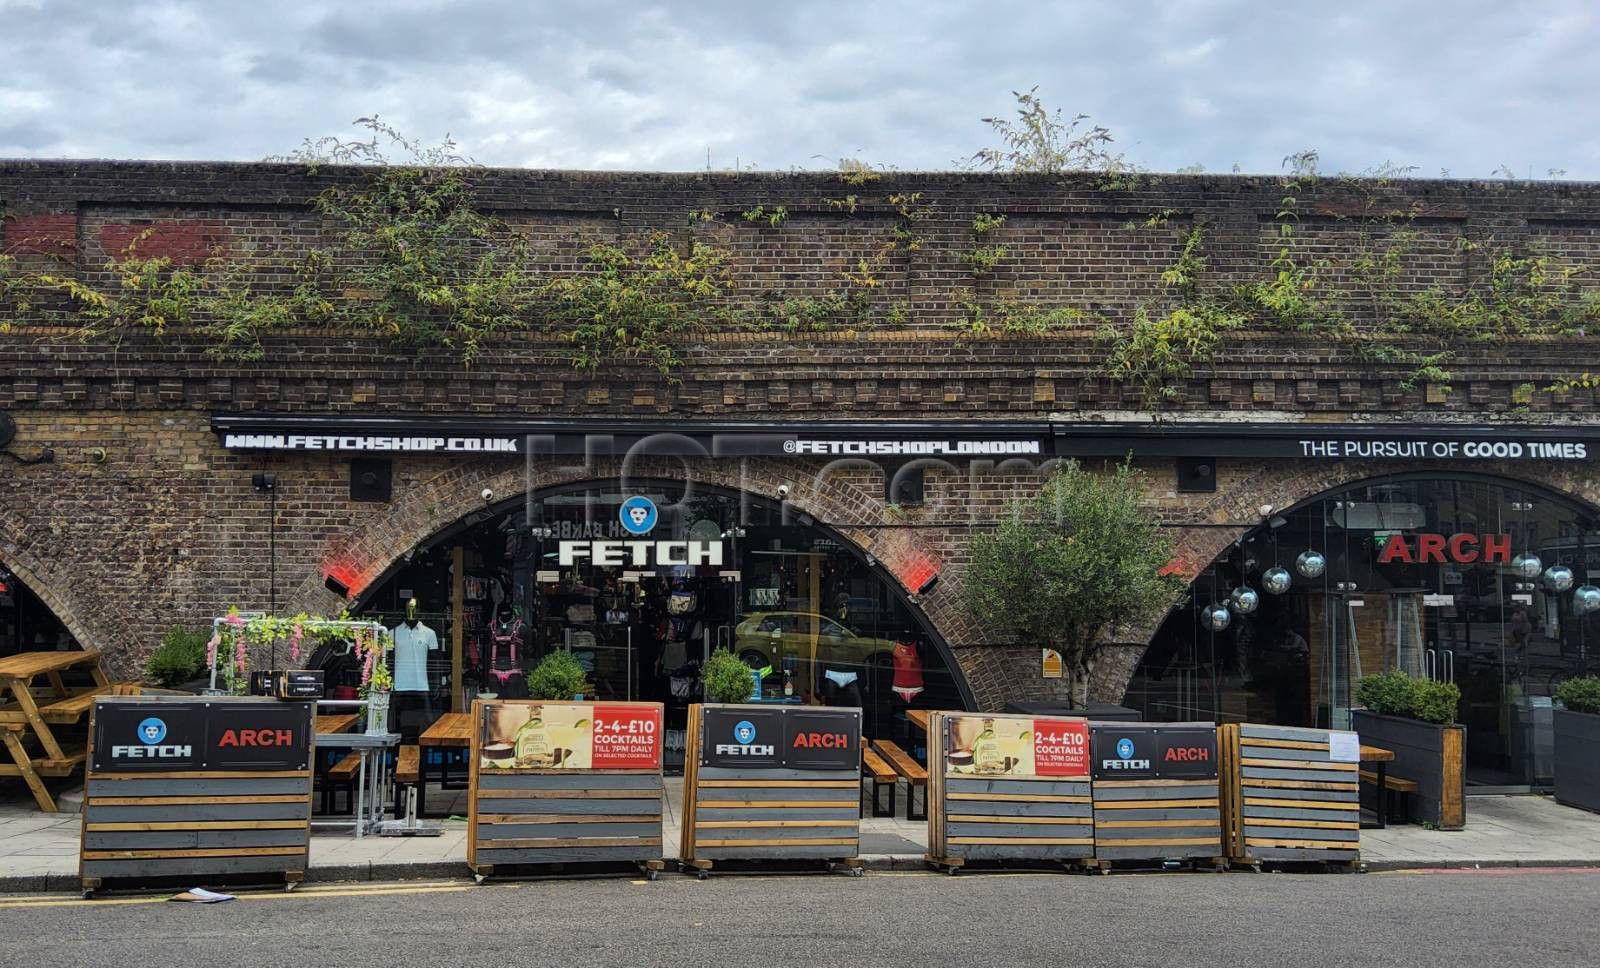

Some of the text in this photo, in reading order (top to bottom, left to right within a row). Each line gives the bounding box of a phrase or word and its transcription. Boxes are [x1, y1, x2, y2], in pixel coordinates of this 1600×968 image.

[225, 434, 518, 452] WWW.FETCHSHOP.CO.UK
[783, 439, 1040, 455] @FETCHSHOPLONDON
[1299, 440, 1587, 459] THE PURSUIT OF GOOD TIMES
[558, 540, 725, 567] FETCH
[1378, 533, 1511, 563] ARCH
[594, 720, 655, 734] 2-4-£10
[218, 729, 293, 747] ARCH
[594, 735, 654, 744] COCKTAILS
[793, 732, 848, 748] ARCH
[1035, 731, 1084, 745] 2-4-£10
[112, 745, 192, 758] FETCH
[612, 745, 629, 753] 7PM
[631, 745, 653, 753] DAILY
[716, 744, 775, 756] FETCH
[1035, 745, 1084, 755] COCKTAILS
[1165, 747, 1209, 760] ARCH
[1065, 755, 1084, 763] DAILY
[1102, 759, 1150, 770] FETCH
